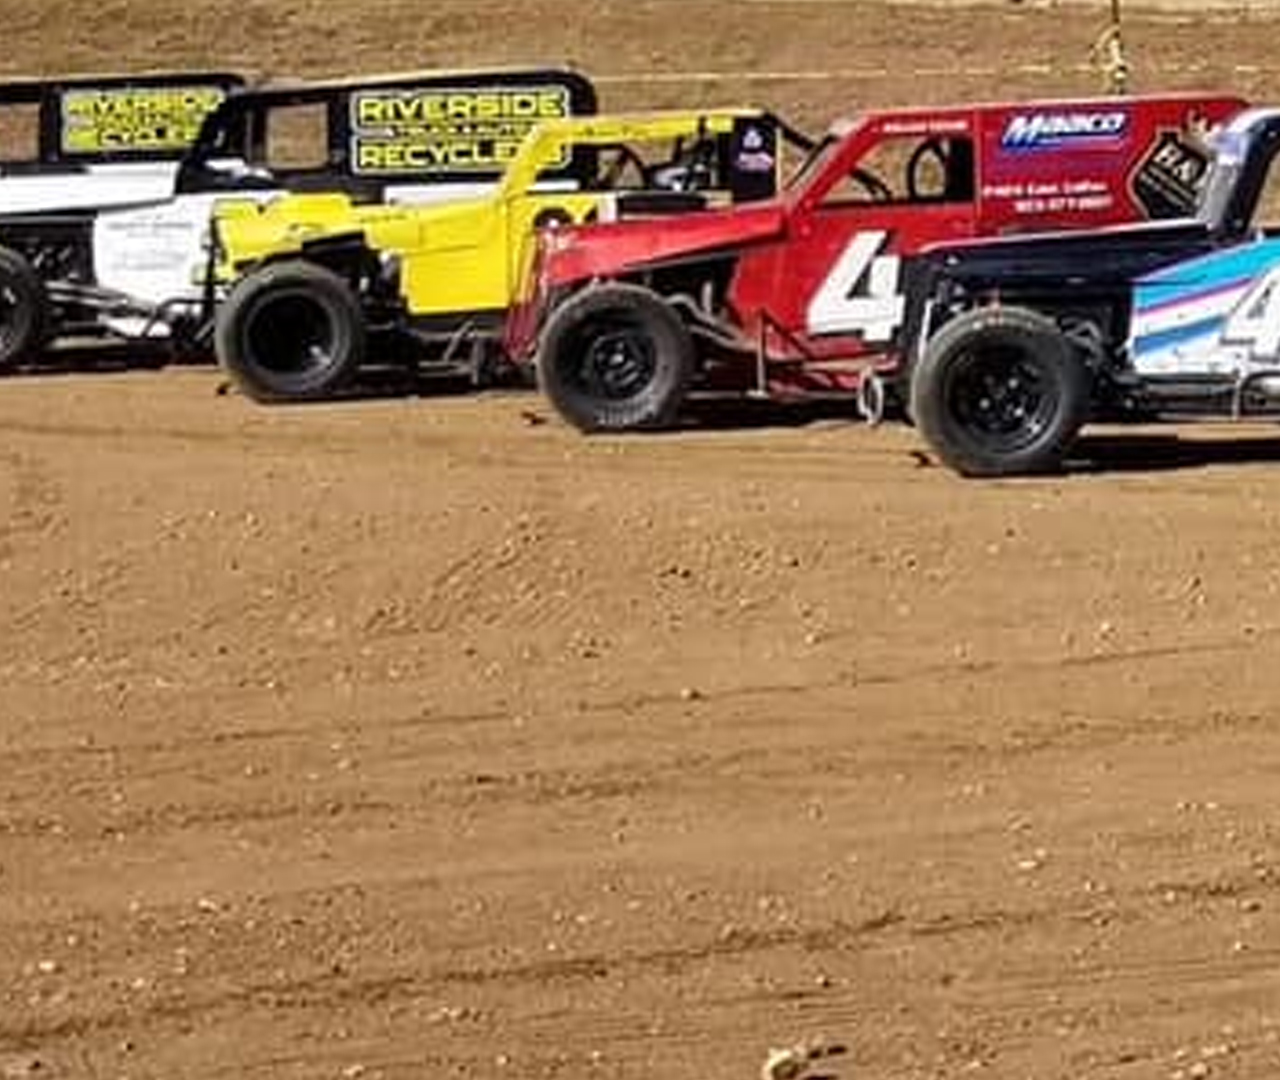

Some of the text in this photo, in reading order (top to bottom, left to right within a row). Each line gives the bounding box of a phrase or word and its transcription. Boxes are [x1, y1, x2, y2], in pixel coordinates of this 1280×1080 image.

[360, 92, 563, 120] RIVERSIDE
[360, 142, 562, 167] RECYCLE
[807, 229, 905, 341] 4
